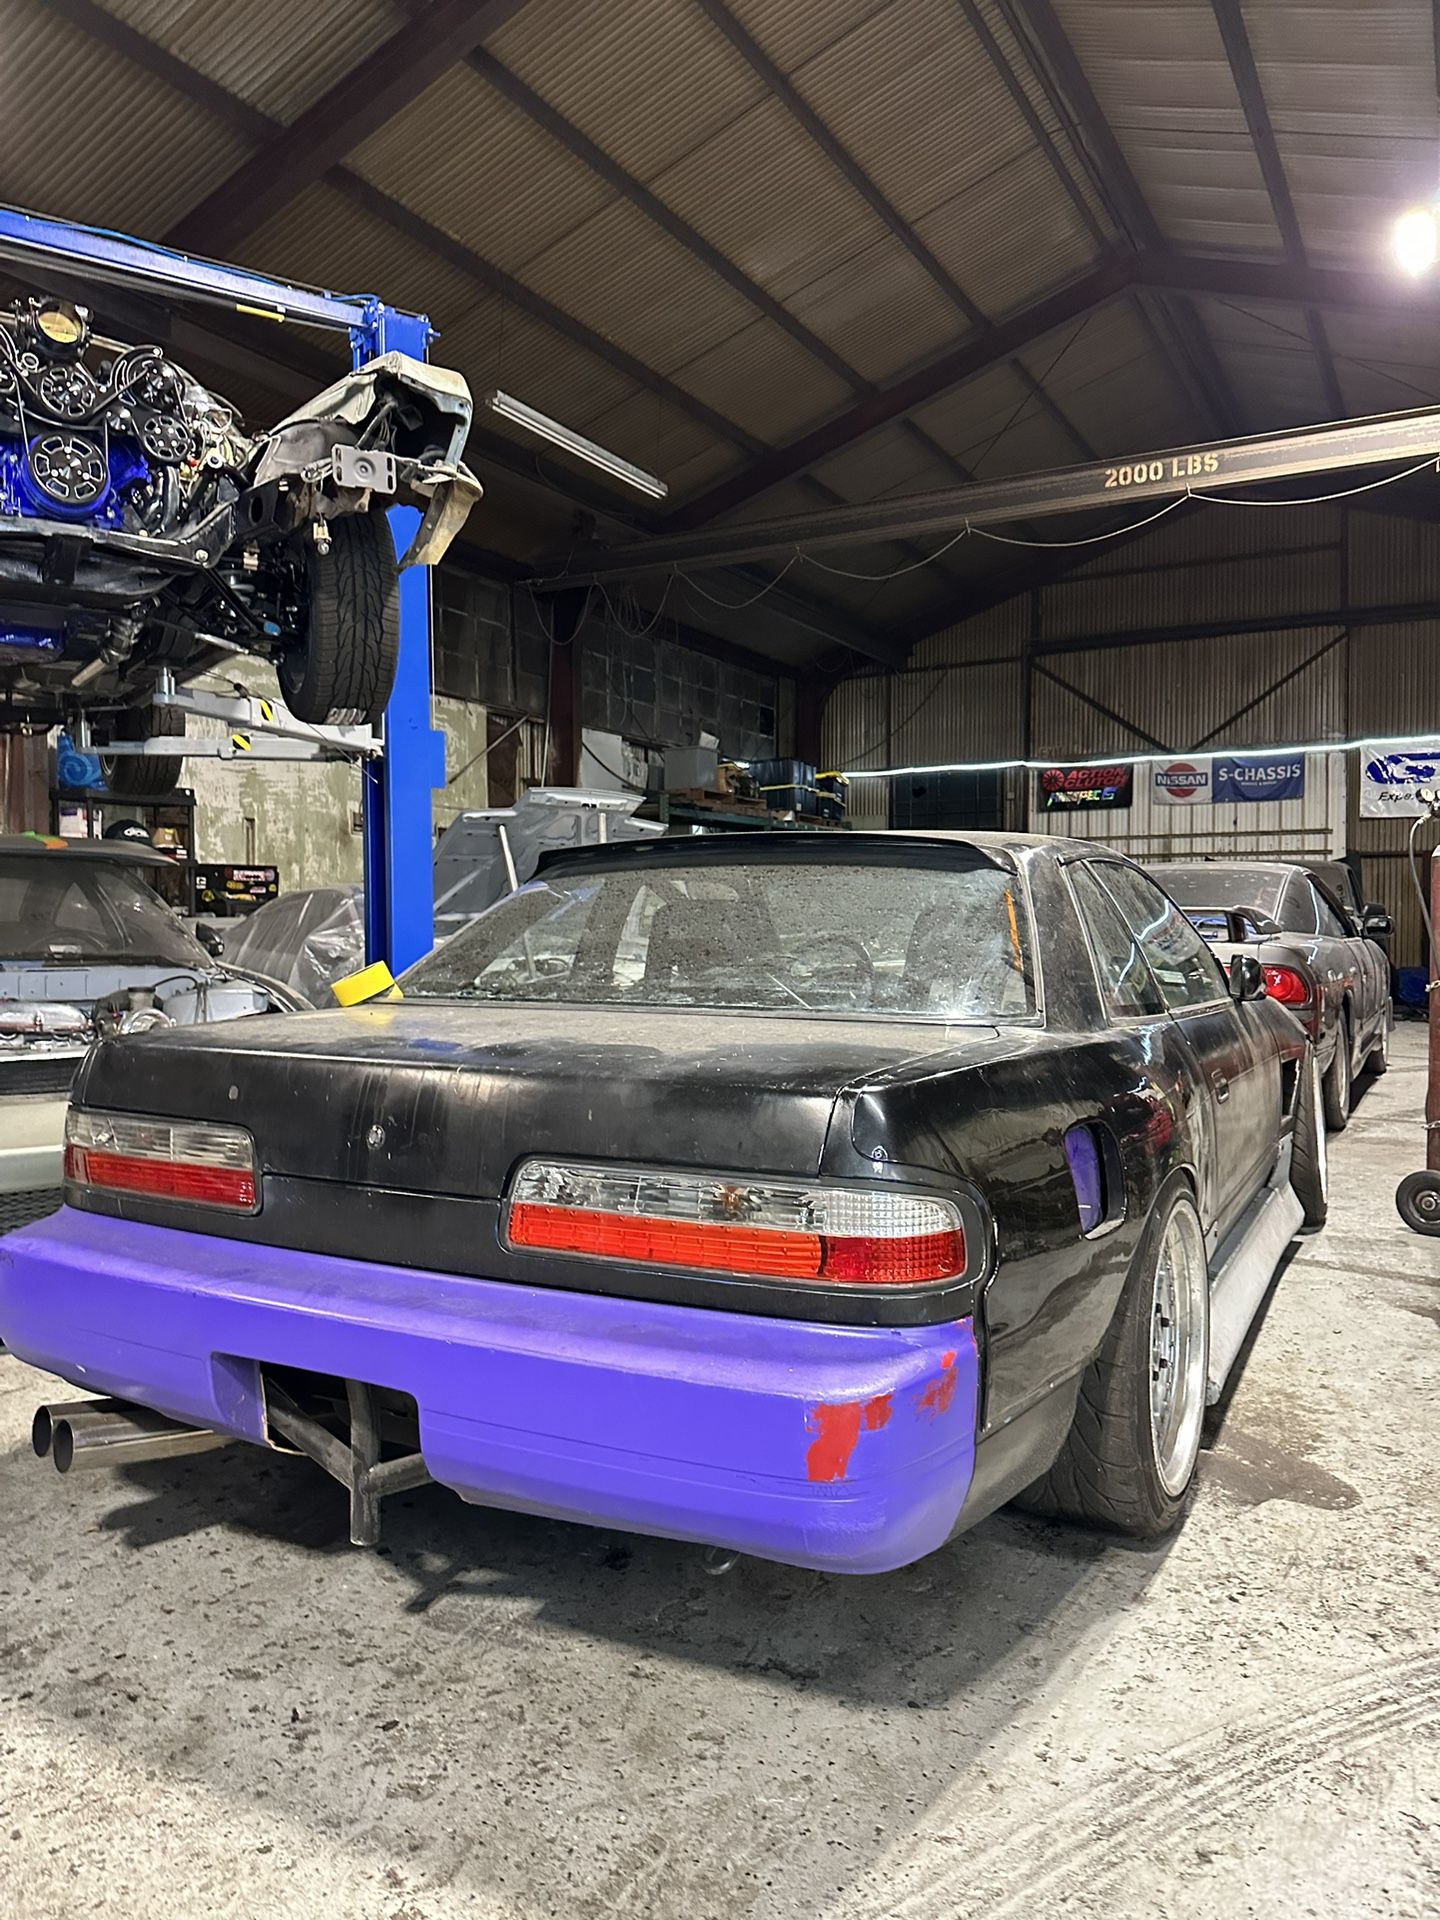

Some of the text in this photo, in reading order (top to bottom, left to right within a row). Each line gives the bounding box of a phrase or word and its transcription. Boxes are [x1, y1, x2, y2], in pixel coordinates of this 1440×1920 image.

[1104, 453, 1219, 488] 2000 LBS
[1067, 767, 1126, 779] ACTION
[1218, 764, 1301, 782] S-CHASSIS
[1064, 776, 1126, 789] CLUTCH
[1156, 774, 1207, 786] NISSAN
